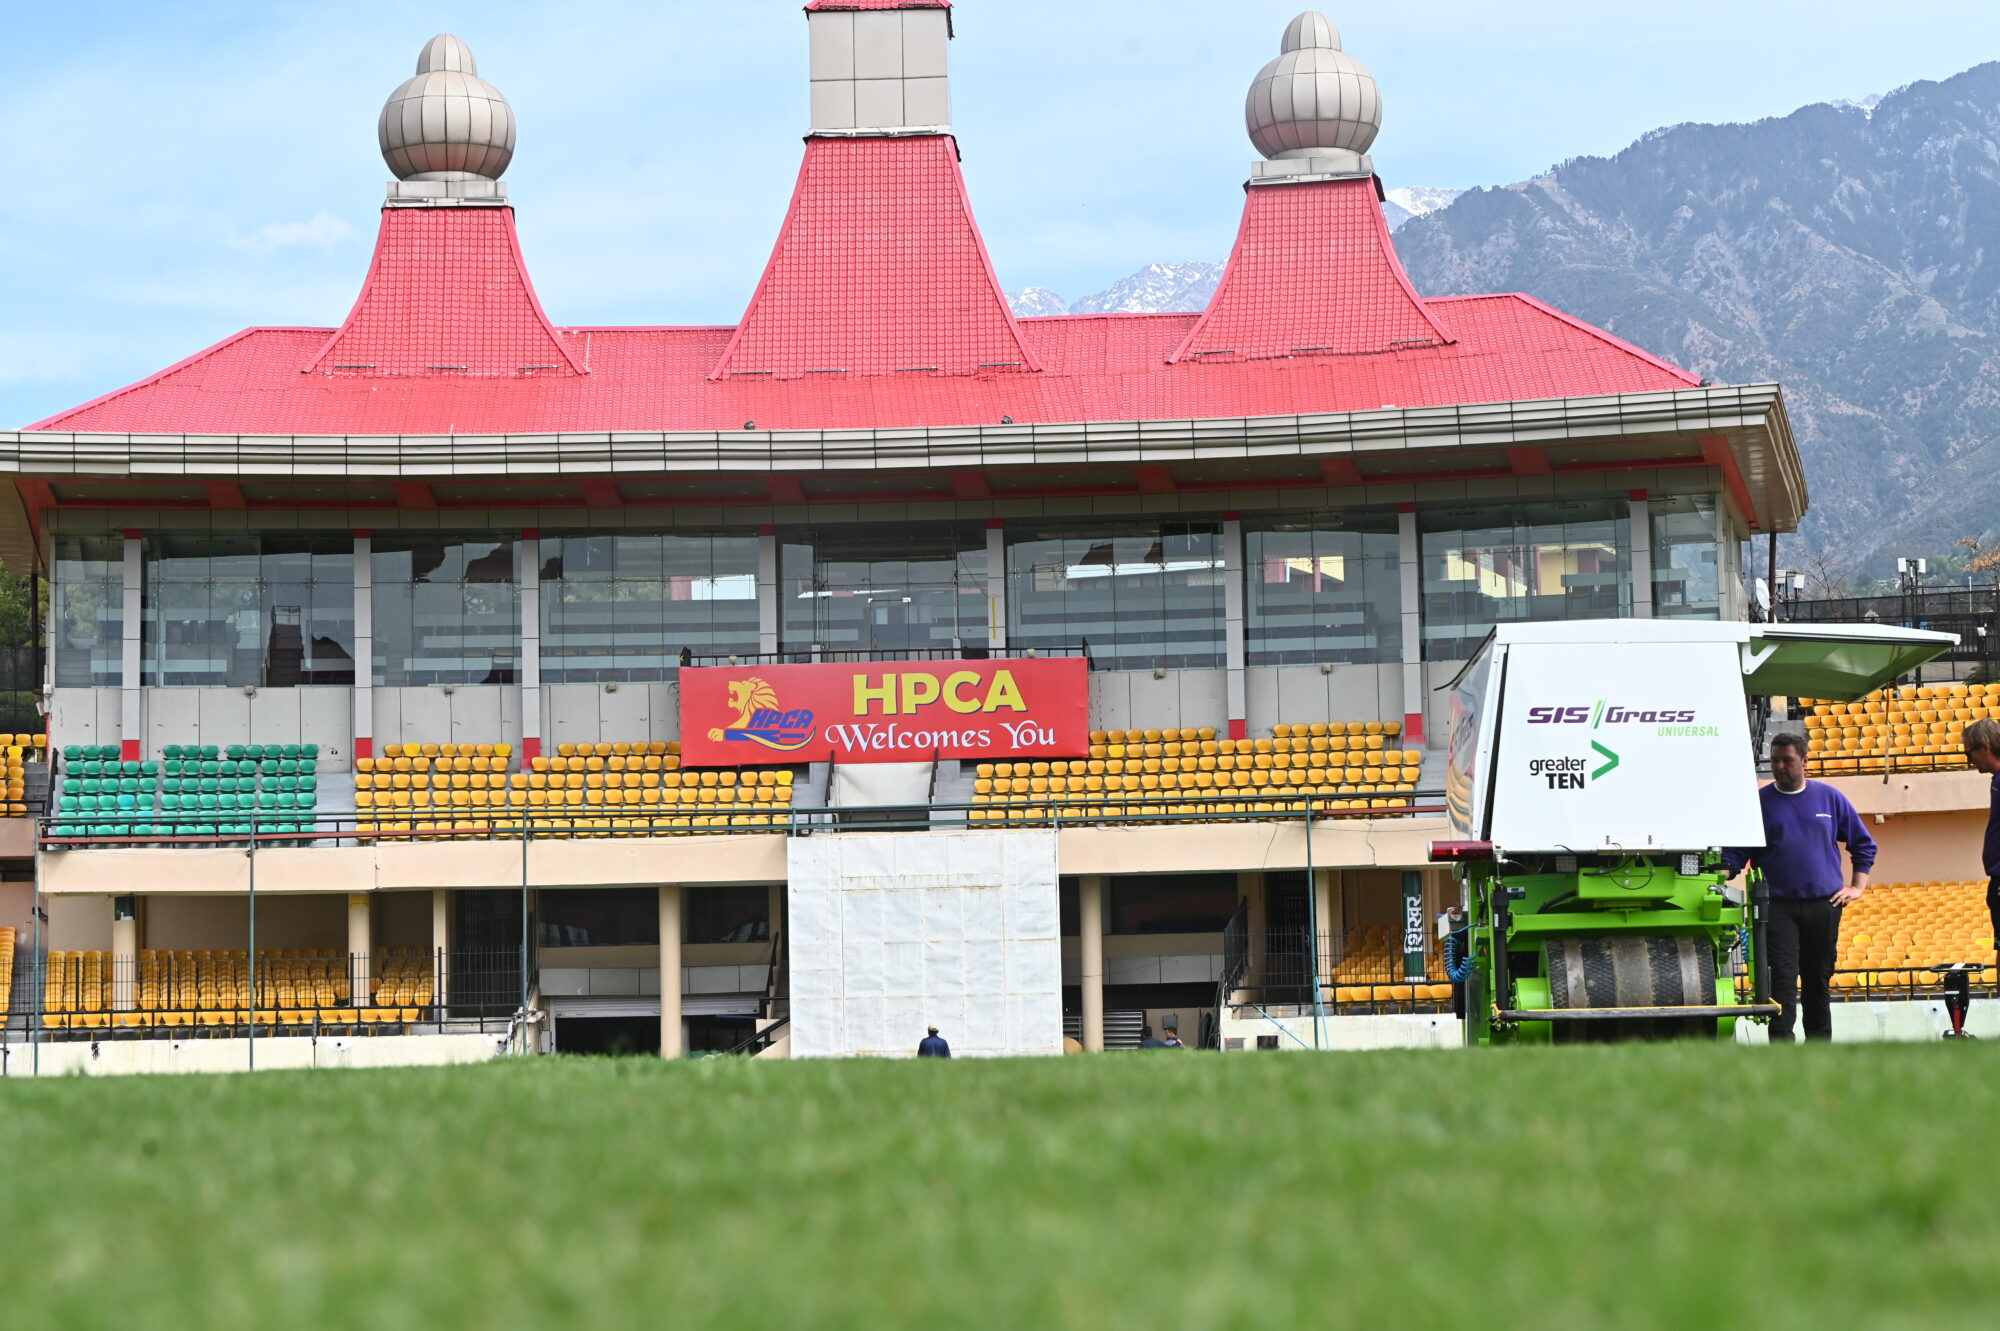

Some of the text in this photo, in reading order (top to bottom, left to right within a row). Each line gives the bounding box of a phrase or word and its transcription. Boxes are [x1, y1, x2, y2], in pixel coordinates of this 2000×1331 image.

[852, 669, 1027, 716] HPCA
[747, 708, 815, 729] HPCA
[1527, 706, 1696, 724] SIS Grass
[824, 719, 1057, 753] Welcomes You
[1657, 726, 1720, 737] UNIVERSAL
[1529, 756, 1587, 776] greater
[1545, 773, 1585, 790] TEN
[1404, 894, 1424, 954] शिखर
